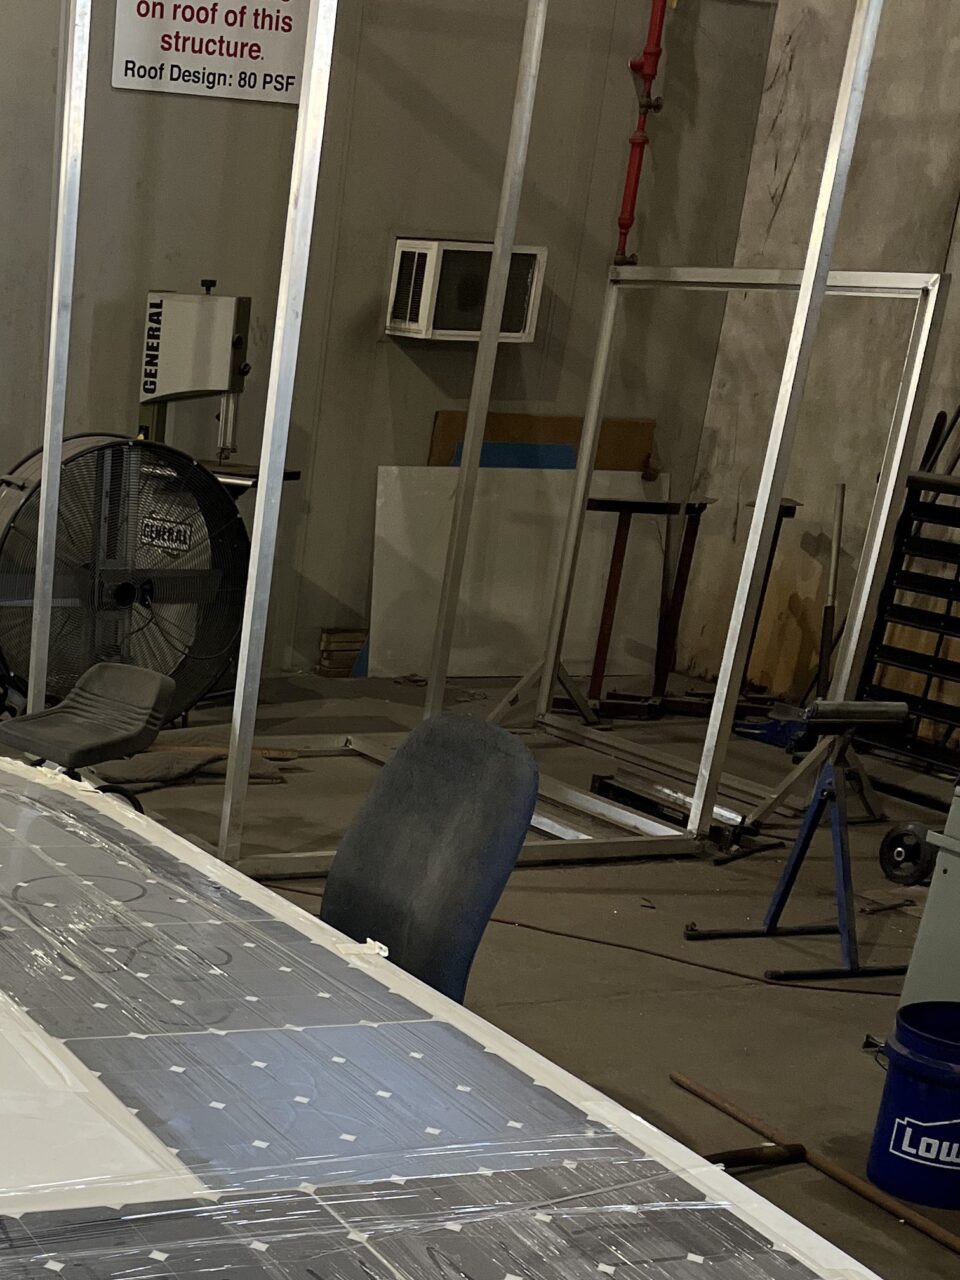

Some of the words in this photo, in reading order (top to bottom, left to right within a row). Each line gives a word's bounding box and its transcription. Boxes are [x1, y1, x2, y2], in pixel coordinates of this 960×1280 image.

[136, 0, 165, 19] on
[172, 3, 219, 25] roof
[224, 6, 247, 28] of
[253, 9, 294, 33] this
[160, 31, 265, 61] structure.
[124, 60, 165, 80] Roof
[169, 64, 233, 90] Design:
[237, 71, 258, 89] 80
[262, 73, 296, 92] PSF
[142, 299, 164, 395] GENERAL
